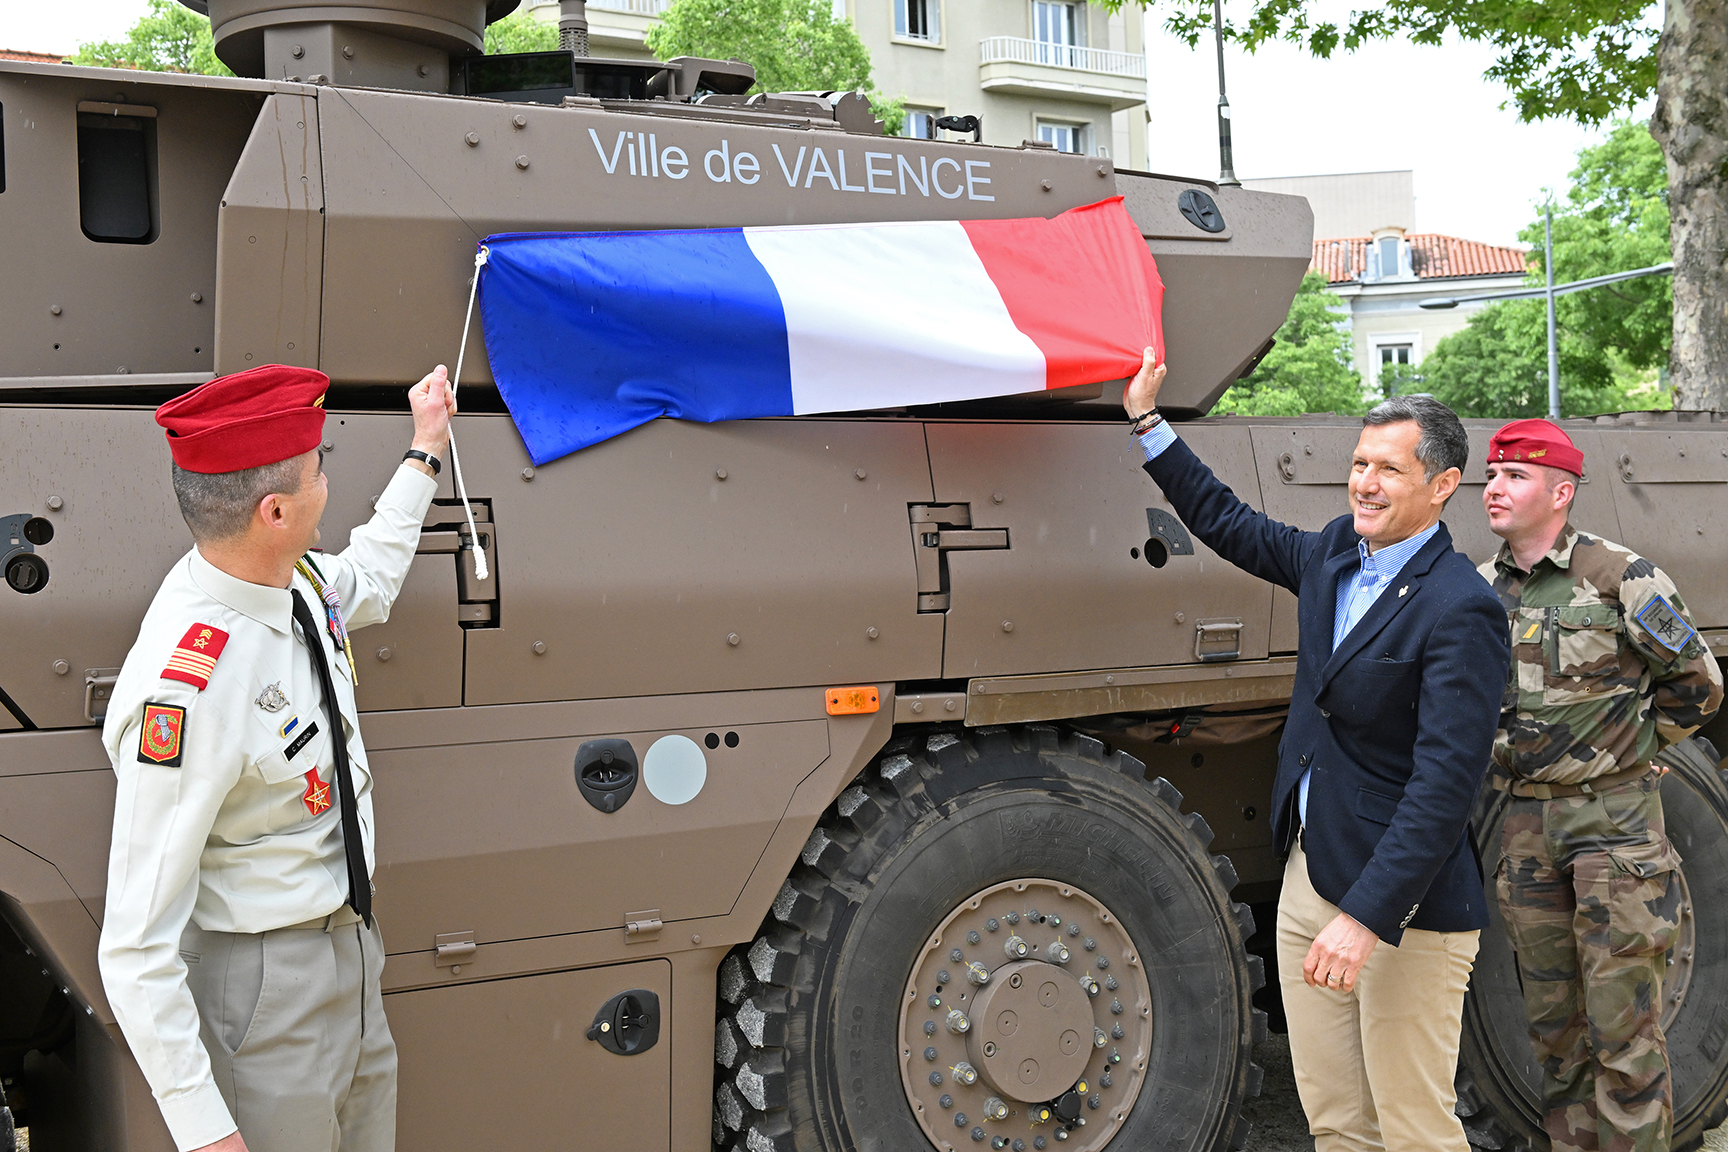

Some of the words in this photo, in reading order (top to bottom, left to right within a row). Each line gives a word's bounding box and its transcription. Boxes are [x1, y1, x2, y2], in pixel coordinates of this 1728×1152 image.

[588, 128, 690, 180] Ville
[704, 139, 760, 185] de
[771, 143, 996, 202] VALENCE
[1045, 812, 1183, 909] MICHELIN
